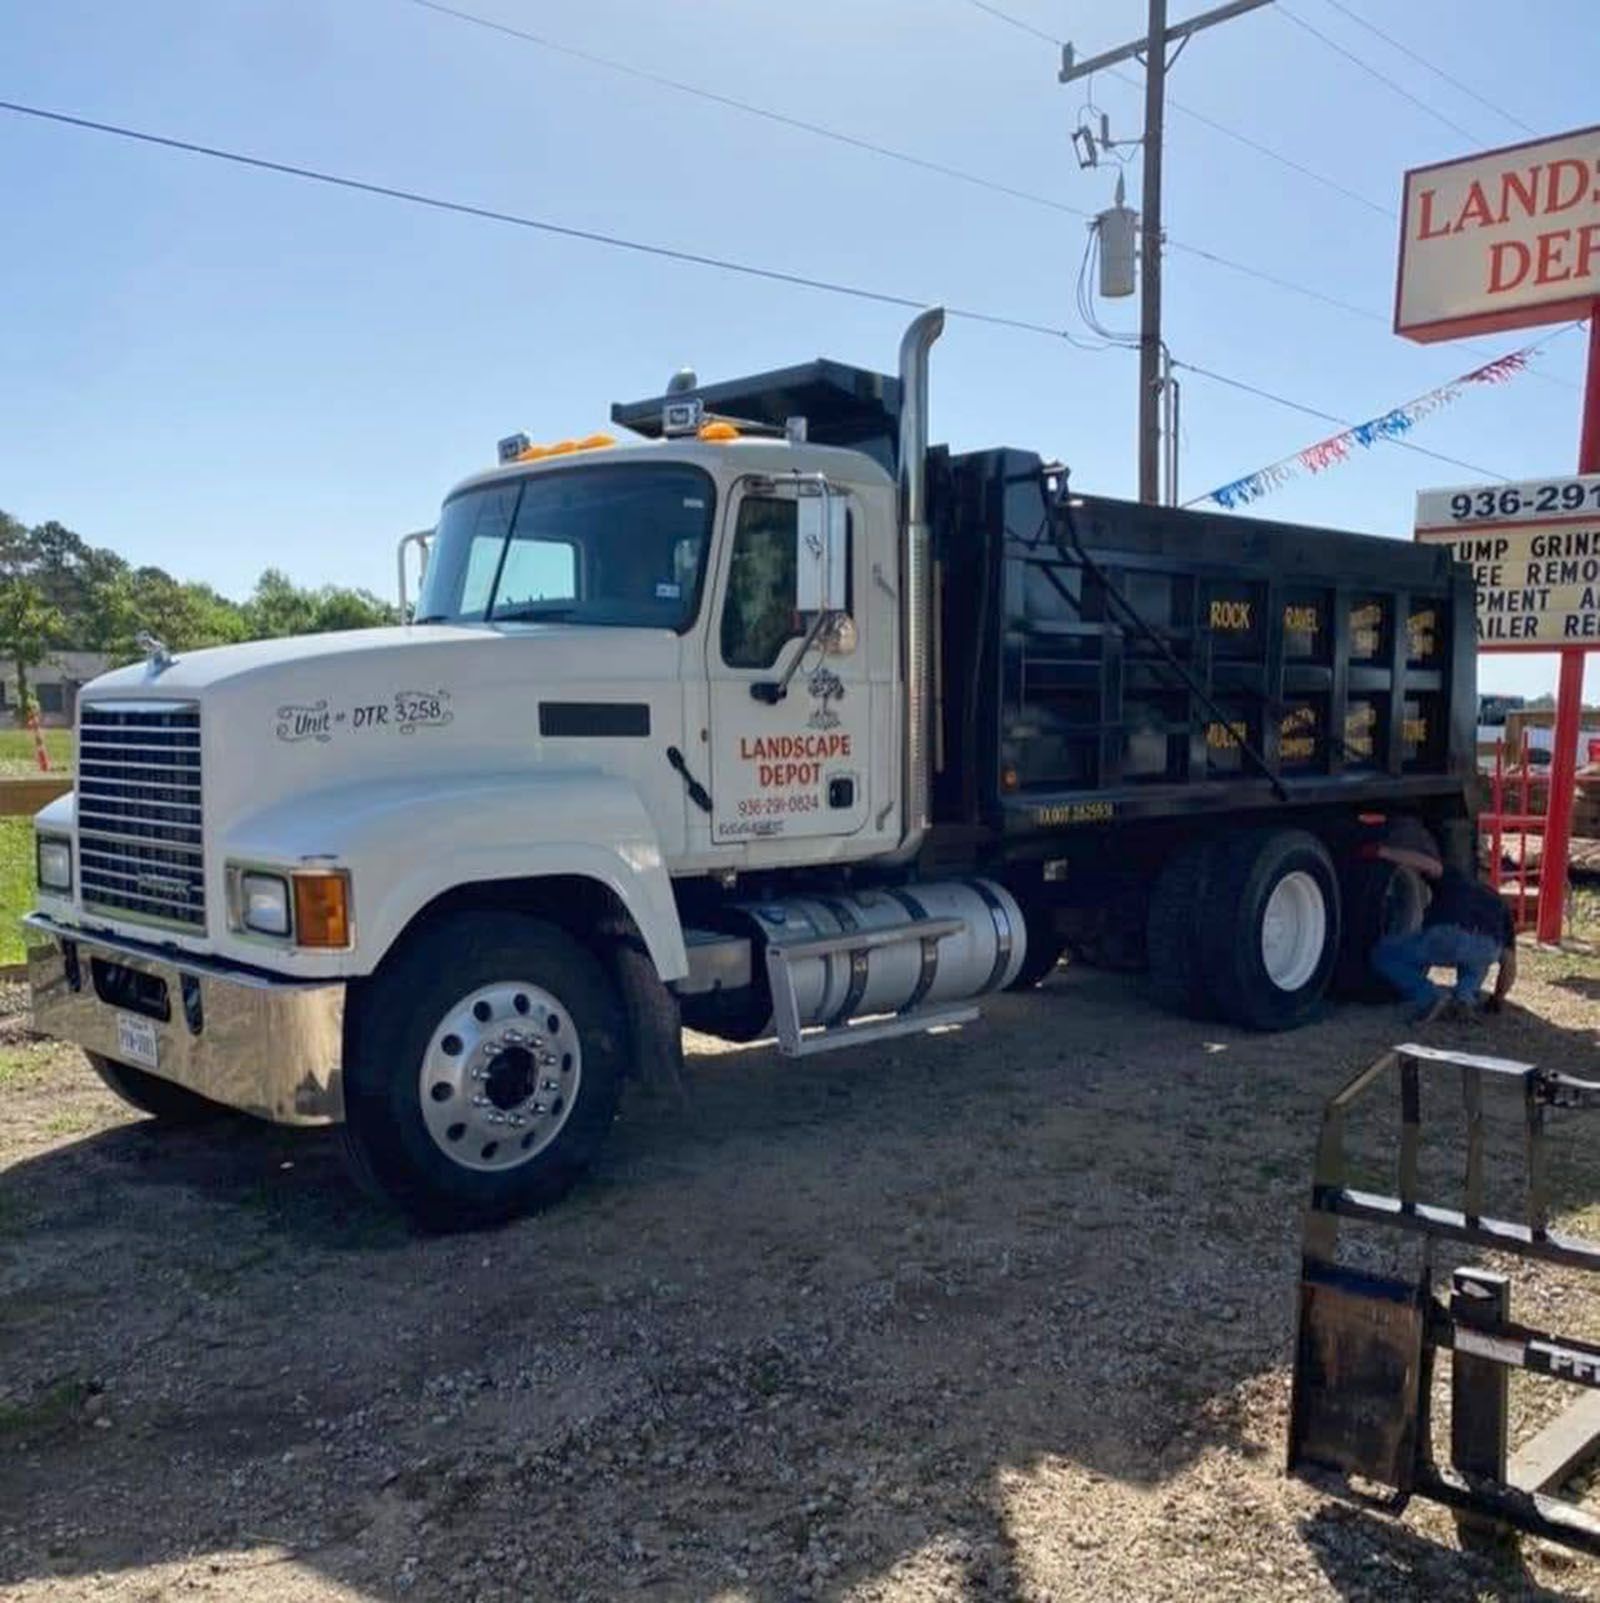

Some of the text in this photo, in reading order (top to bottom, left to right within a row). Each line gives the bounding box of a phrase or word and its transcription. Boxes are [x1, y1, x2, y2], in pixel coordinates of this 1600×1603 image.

[1450, 539, 1509, 562] TUMP
[1474, 588, 1550, 613] PMENT
[1209, 601, 1251, 629] ROCK
[1477, 614, 1600, 639] AILER RE
[295, 712, 331, 736] Unit
[353, 705, 389, 728] DTR
[394, 700, 442, 723] 3258
[740, 734, 852, 760] LANDSCAPE
[759, 763, 821, 787] DEPOT
